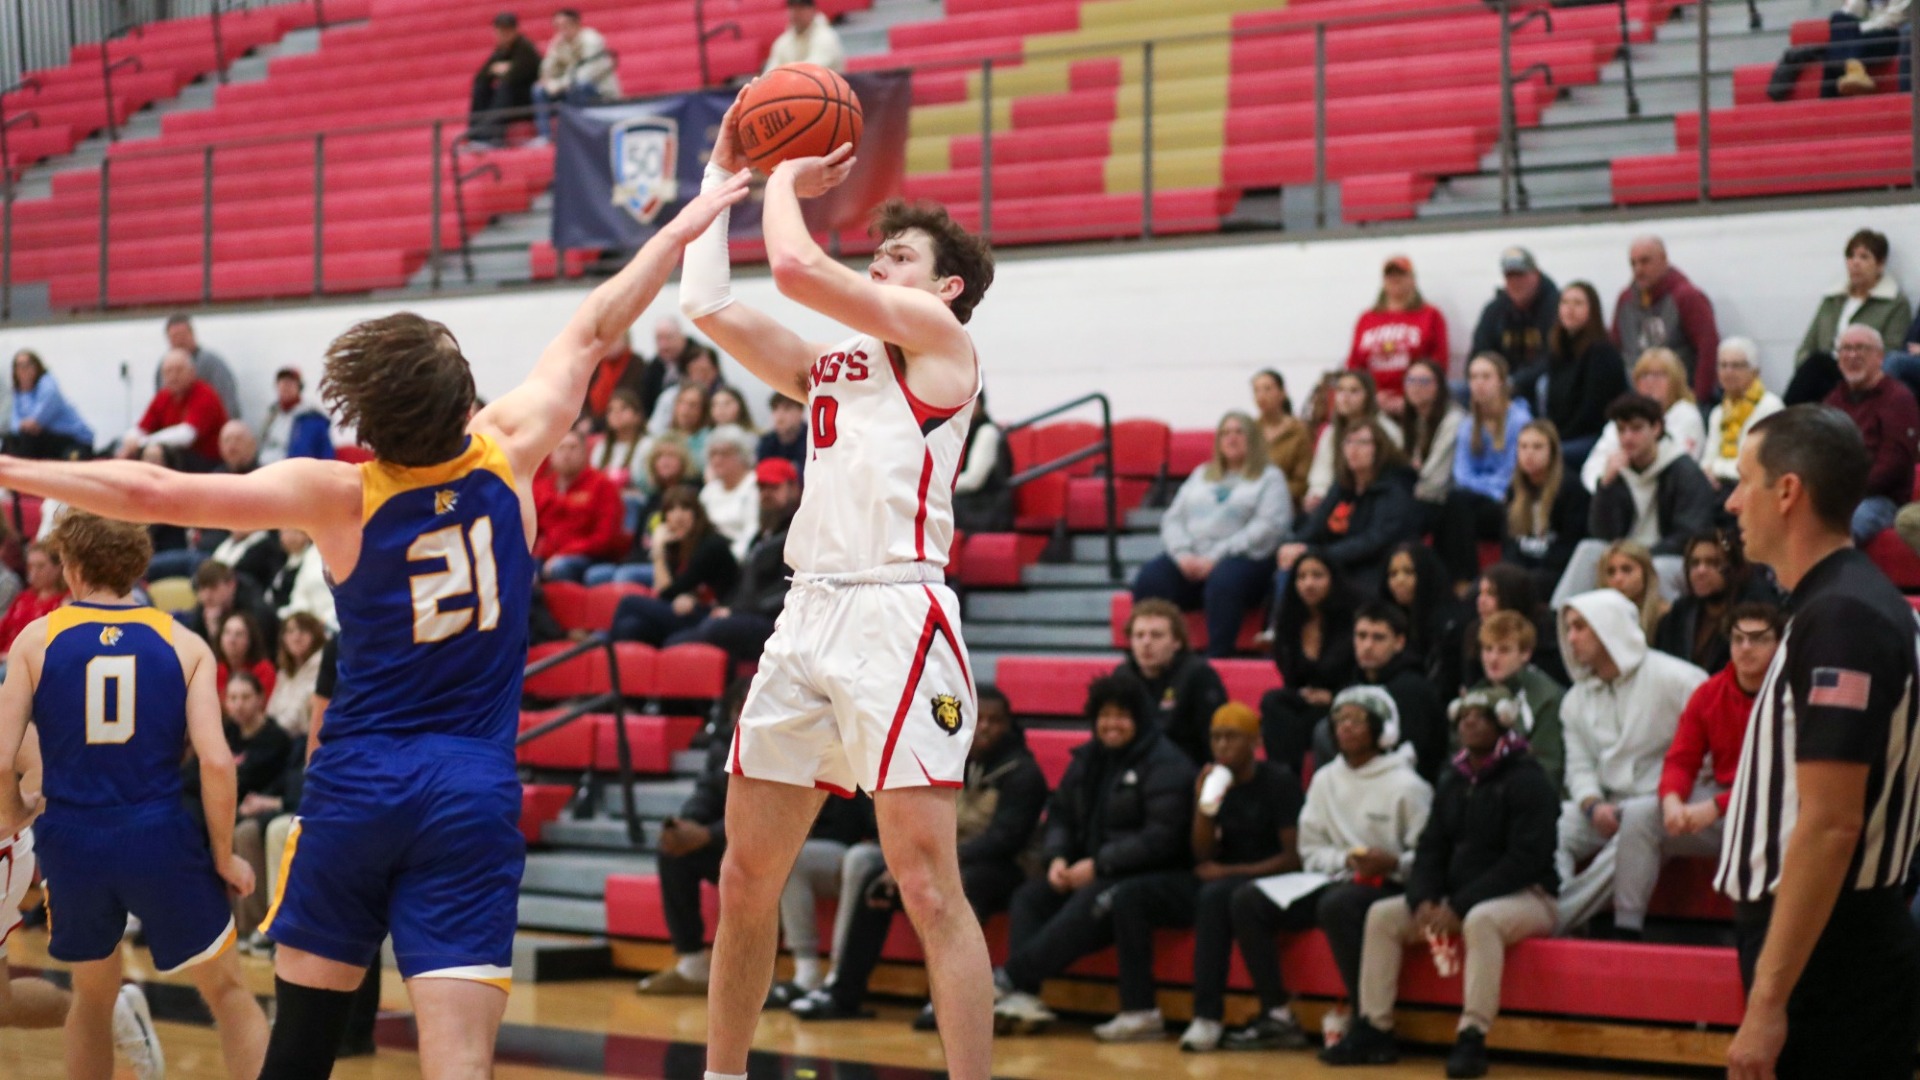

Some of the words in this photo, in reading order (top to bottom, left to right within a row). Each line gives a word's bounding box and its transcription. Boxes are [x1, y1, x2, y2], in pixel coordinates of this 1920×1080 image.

[758, 105, 796, 140] THE
[406, 515, 501, 644] 21
[86, 655, 136, 744] 0
